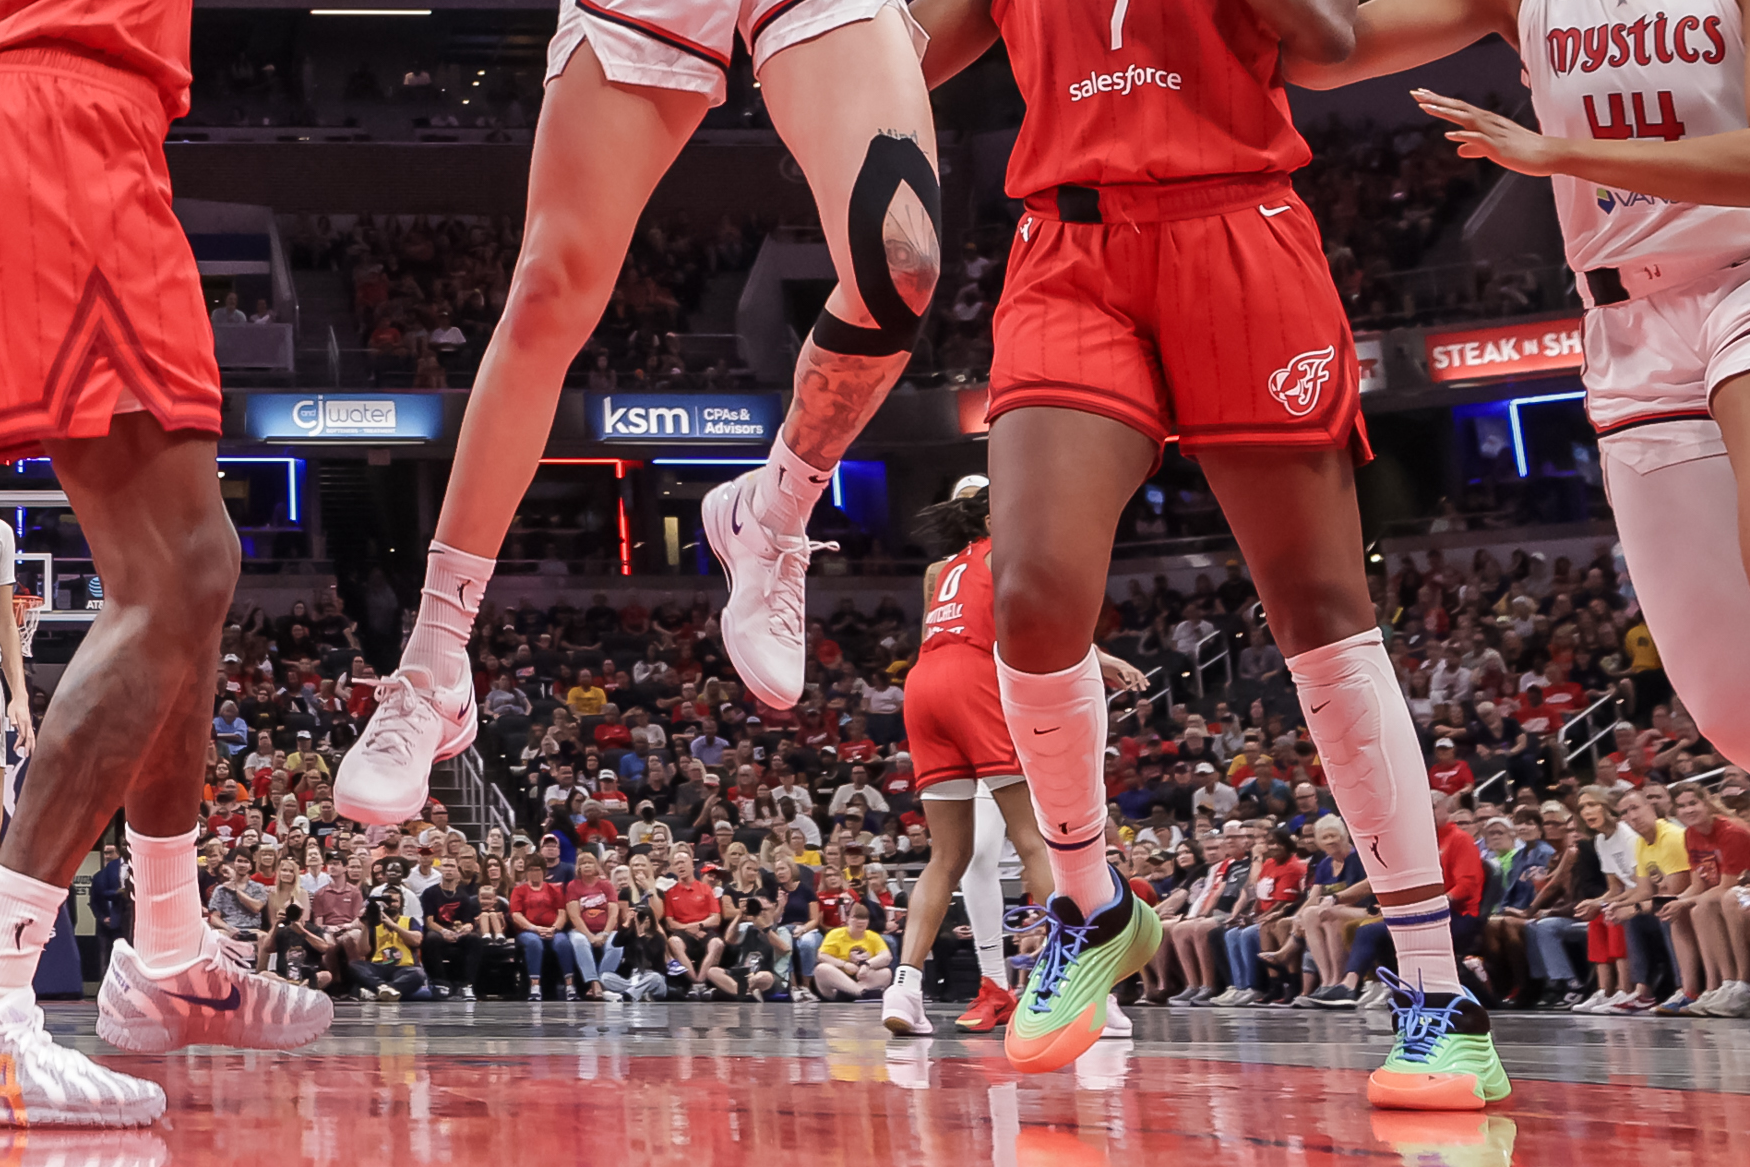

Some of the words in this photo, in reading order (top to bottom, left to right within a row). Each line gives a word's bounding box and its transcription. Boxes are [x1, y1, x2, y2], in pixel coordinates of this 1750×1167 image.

[1547, 11, 1726, 79] mystics
[1069, 64, 1182, 102] salesforce
[1582, 90, 1686, 142] 44
[1432, 338, 1521, 371] STEAK
[328, 403, 393, 423] water
[604, 396, 690, 434] ksm
[704, 408, 738, 421] CPAs
[739, 409, 751, 421] &
[705, 421, 765, 434] Advisors
[937, 563, 967, 603] 0
